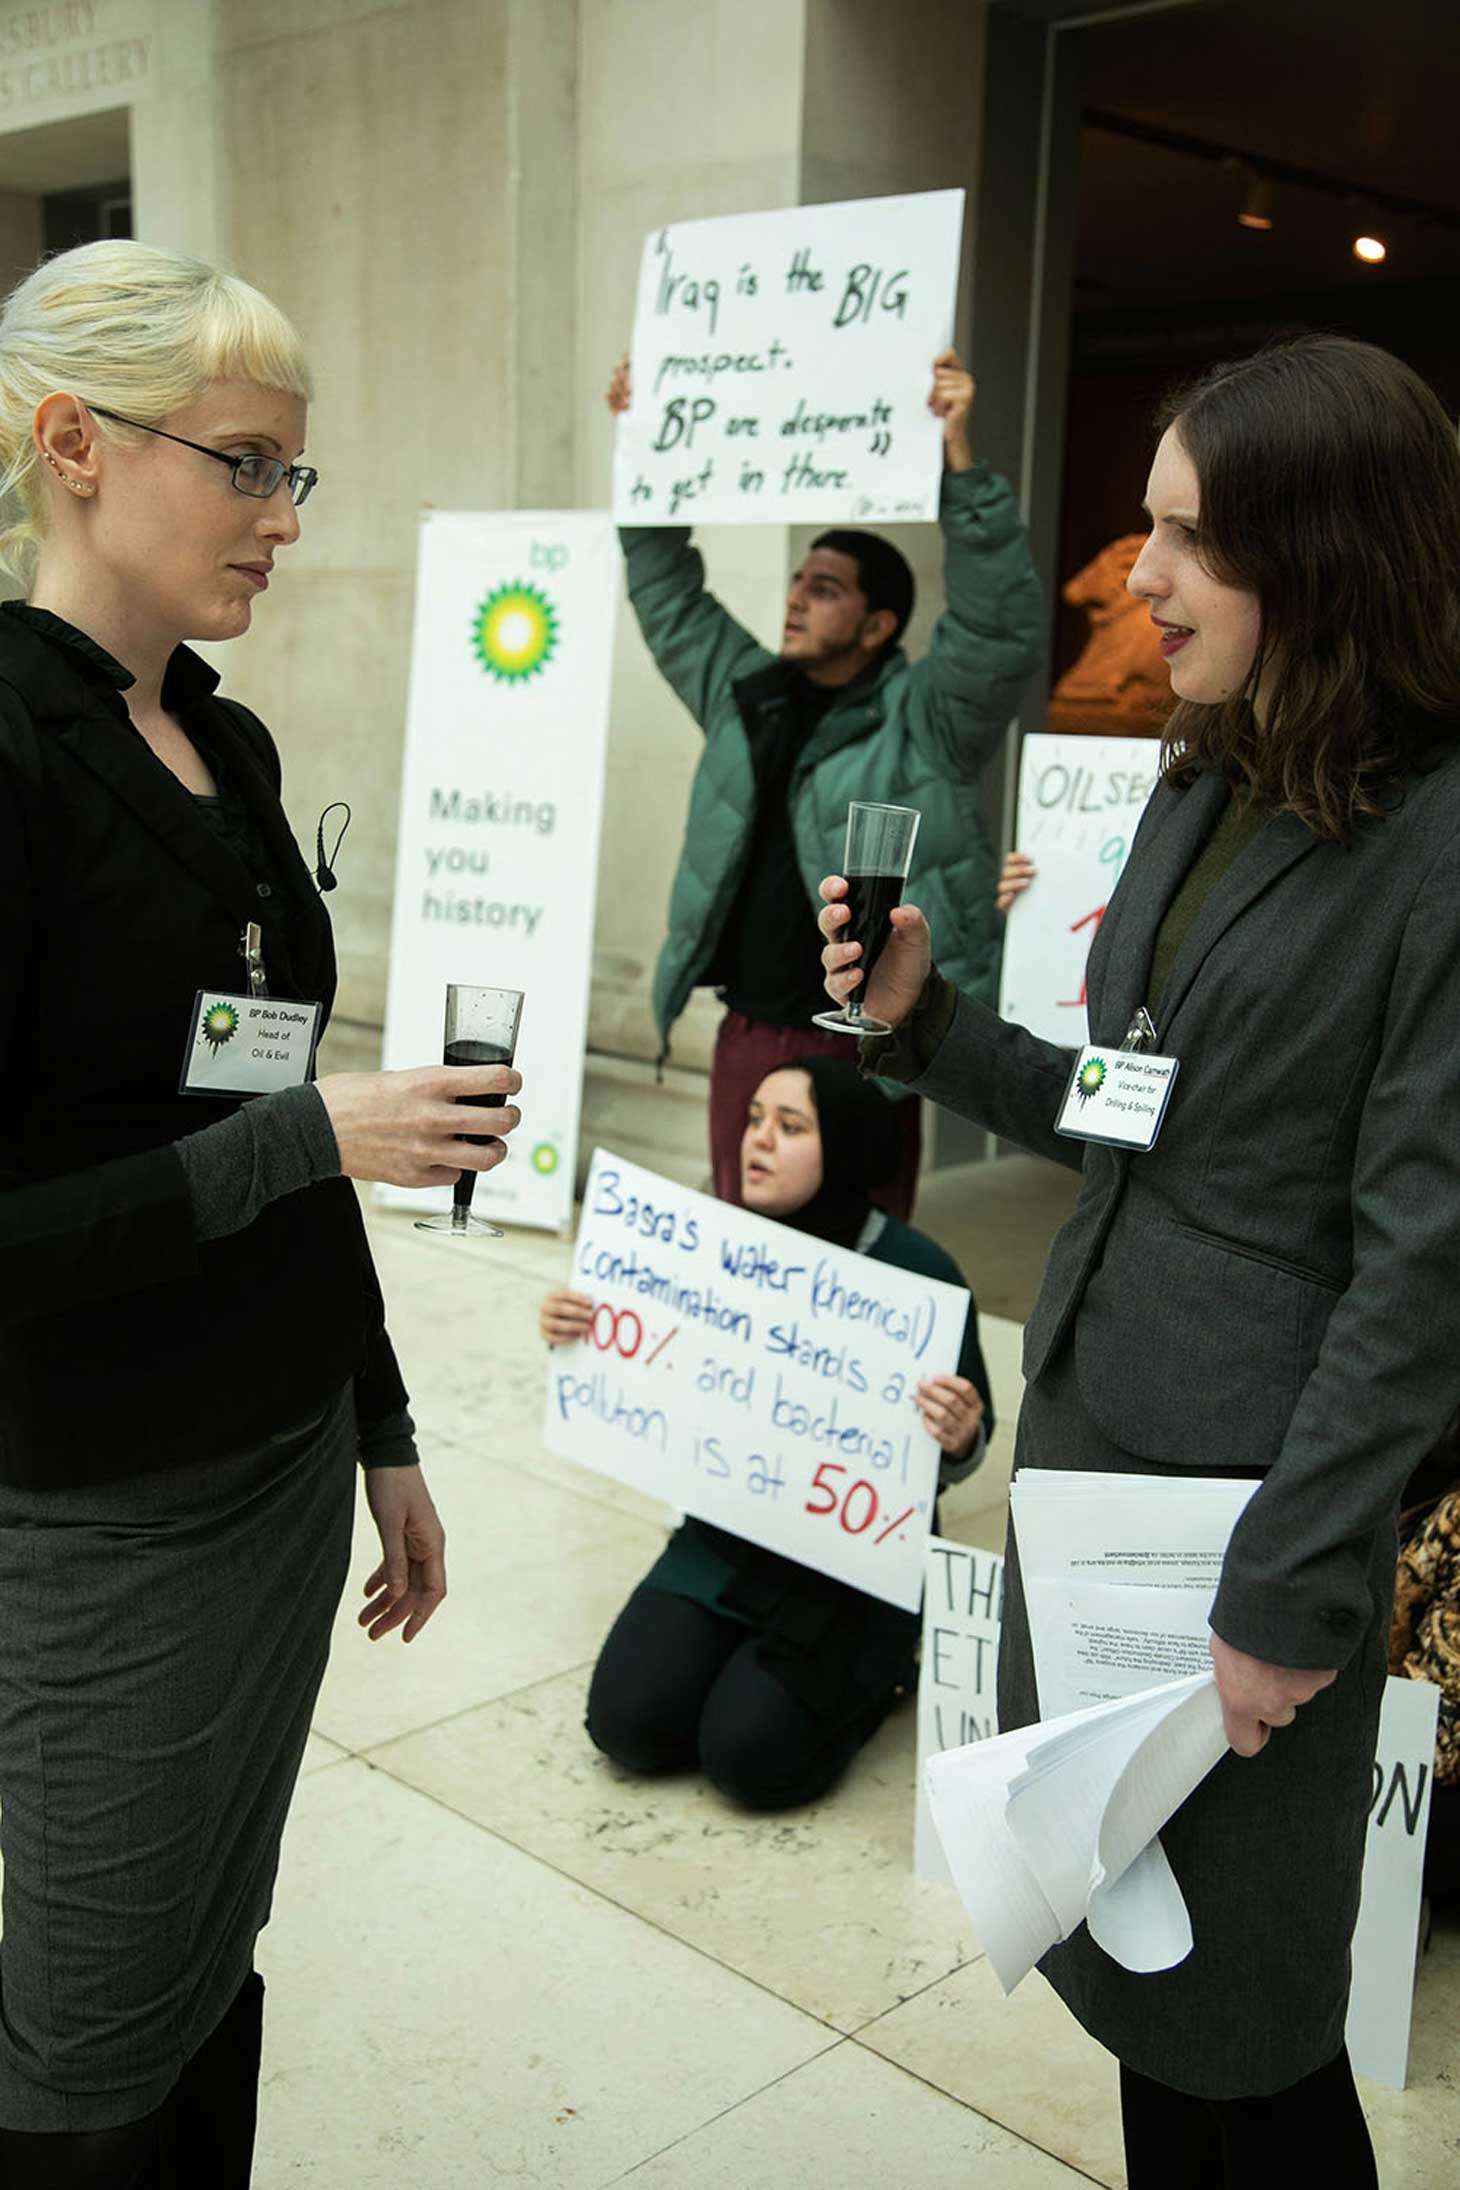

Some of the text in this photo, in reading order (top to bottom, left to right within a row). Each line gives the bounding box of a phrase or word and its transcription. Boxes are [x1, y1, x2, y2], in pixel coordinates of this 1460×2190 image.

[737, 263, 758, 296] is
[786, 248, 825, 294] the
[832, 264, 910, 328] BIG
[652, 397, 894, 452] BP are desperate
[630, 475, 653, 505] to
[671, 458, 714, 516] get
[738, 461, 764, 494] in
[528, 539, 568, 570] bp
[428, 786, 557, 835] Making
[424, 846, 489, 876] you
[421, 892, 543, 936] history
[249, 1009, 309, 1025] BP Bob Dudley
[257, 1029, 291, 1040] Head of
[251, 1048, 290, 1060] Oil & Evil
[1114, 1061, 1125, 1069] BP
[766, 1323, 868, 1393] stands
[583, 1303, 911, 1484] 00% and bacterial
[695, 1436, 730, 1478] is
[748, 1453, 786, 1500] at
[805, 1462, 915, 1546] 50%
